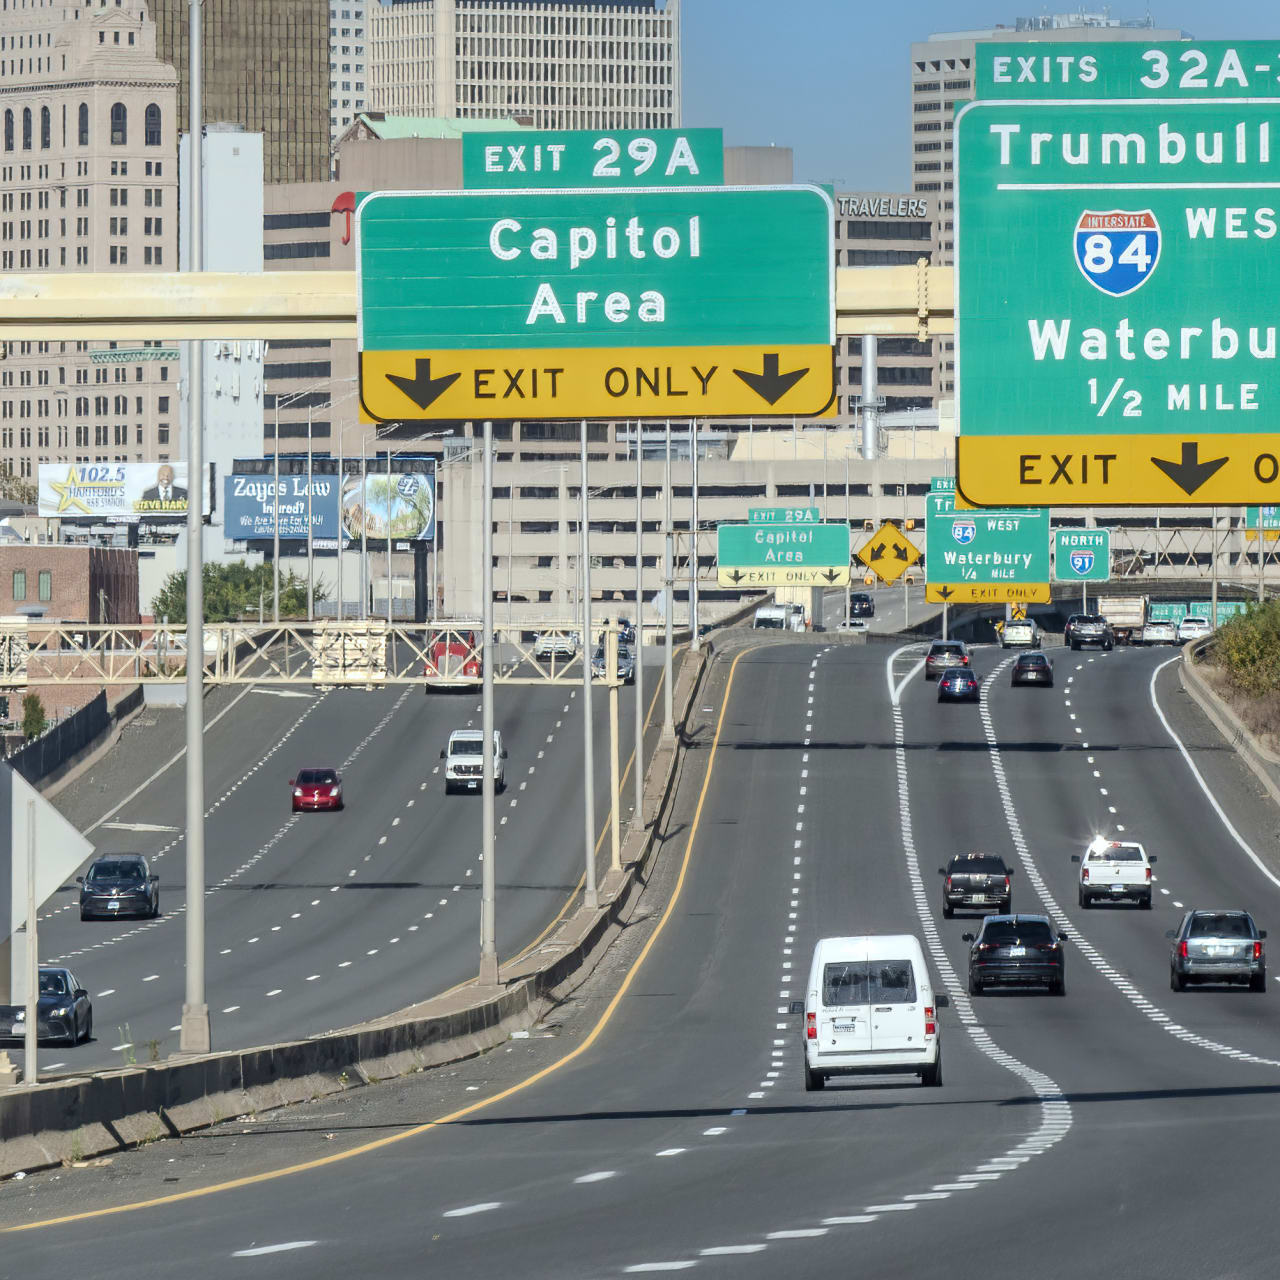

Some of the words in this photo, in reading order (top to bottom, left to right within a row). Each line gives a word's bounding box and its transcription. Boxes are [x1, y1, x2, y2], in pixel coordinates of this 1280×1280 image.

[993, 56, 1098, 83] EXITS
[990, 122, 1270, 166] Trumbull
[485, 144, 565, 173] EXIT
[592, 137, 699, 177] 29A
[838, 197, 928, 217] TRAVELERS
[1088, 215, 1147, 228] INTERSTATE
[489, 215, 701, 269] Capitol
[1083, 234, 1152, 273] 84
[525, 283, 666, 324] Area
[474, 368, 564, 399] EXIT
[604, 365, 718, 398] ONLY
[1088, 378, 1143, 417] 1/2
[1168, 384, 1260, 411] MILE
[79, 467, 126, 482] 102.5
[1020, 454, 1117, 485] EXIT
[754, 511, 775, 520] EXIT
[785, 510, 813, 522] 29A
[955, 526, 973, 538] 84
[987, 520, 1020, 531] WEST
[755, 530, 813, 545] Capitol
[1061, 535, 1104, 546] NORTH
[765, 548, 803, 562] Area
[944, 552, 1033, 569] Waterbury
[1073, 557, 1090, 569] 91
[749, 572, 776, 582] EXIT
[786, 571, 818, 581] ONLY
[961, 568, 977, 580] 1/4
[992, 569, 1015, 579] MILE
[971, 588, 998, 598] EXIT
[1007, 588, 1037, 598] ONLY
